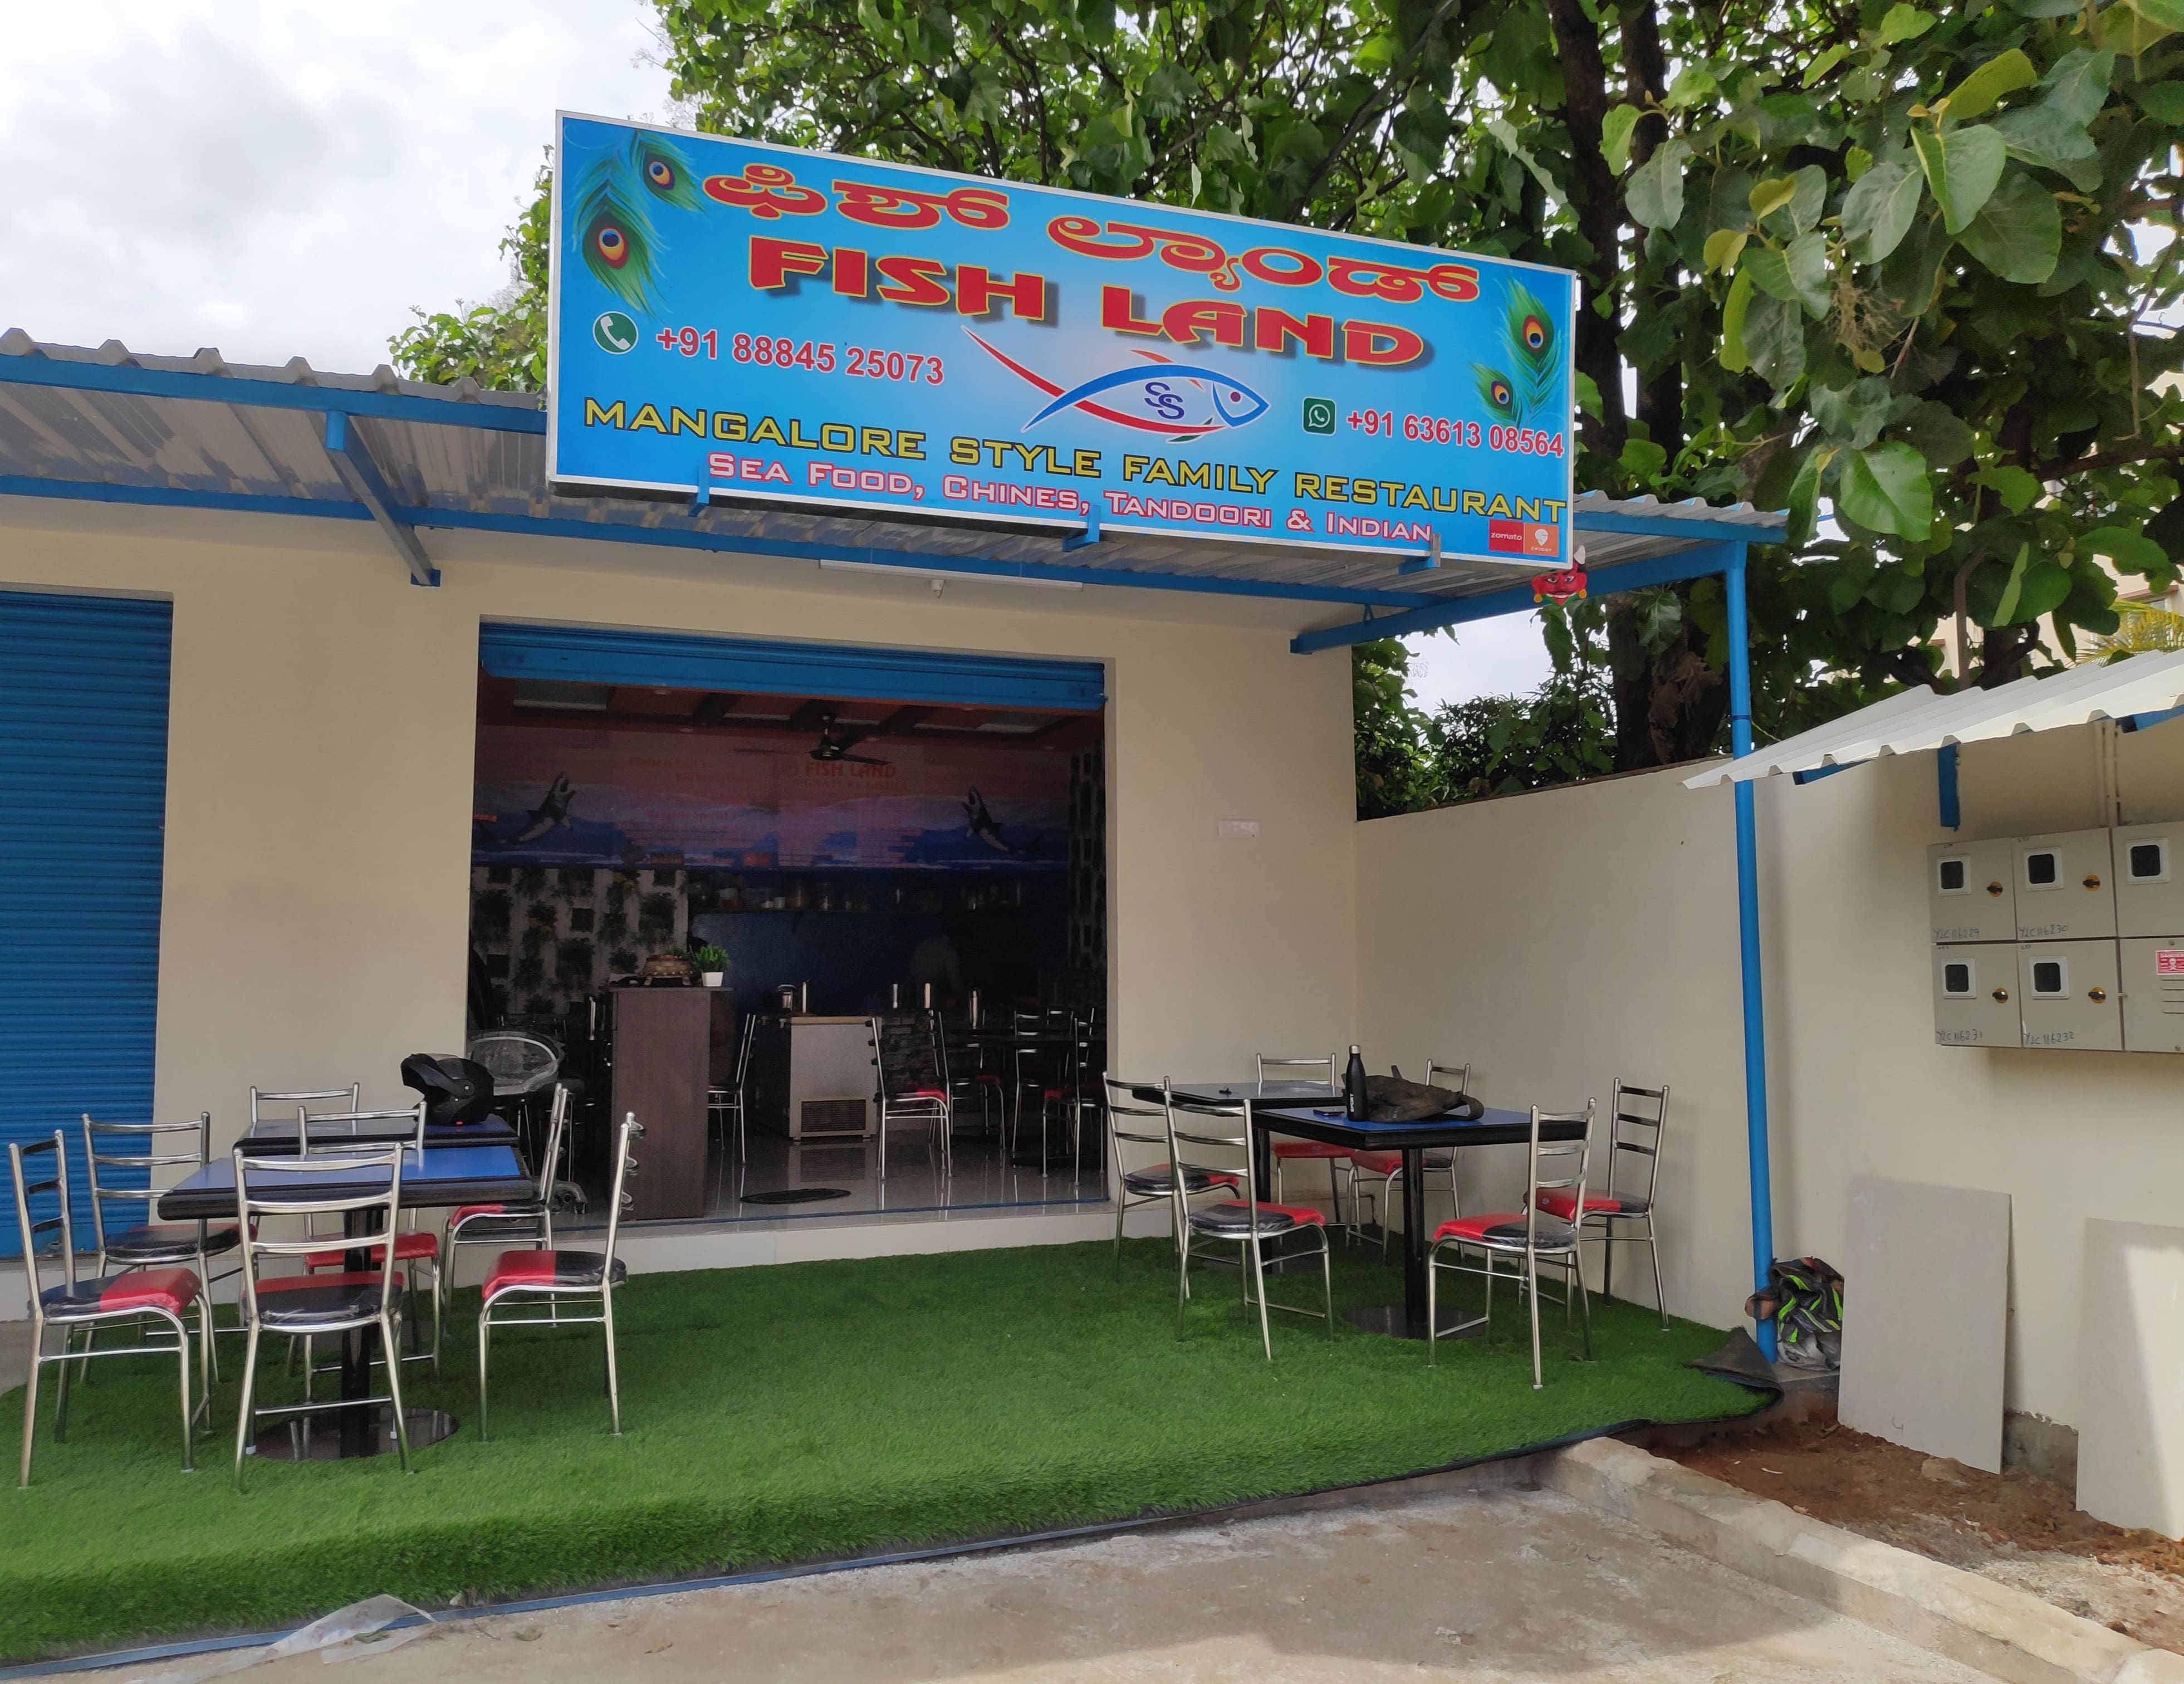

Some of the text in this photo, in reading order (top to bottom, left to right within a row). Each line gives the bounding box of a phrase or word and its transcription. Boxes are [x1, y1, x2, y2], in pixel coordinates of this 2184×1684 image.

[749, 236, 1424, 366] FISH LAND
[657, 326, 944, 385] +91 88845 25073
[584, 397, 1567, 524] MANGALORE STYLE FAMILY RESTAURANT
[1347, 410, 1565, 458] +91 63613 08564
[707, 452, 1433, 543] SEA FOOD, CHINES, TANDOORI & INDIAN
[1491, 532, 1522, 541] zomato
[805, 761, 896, 778] FISH LAND
